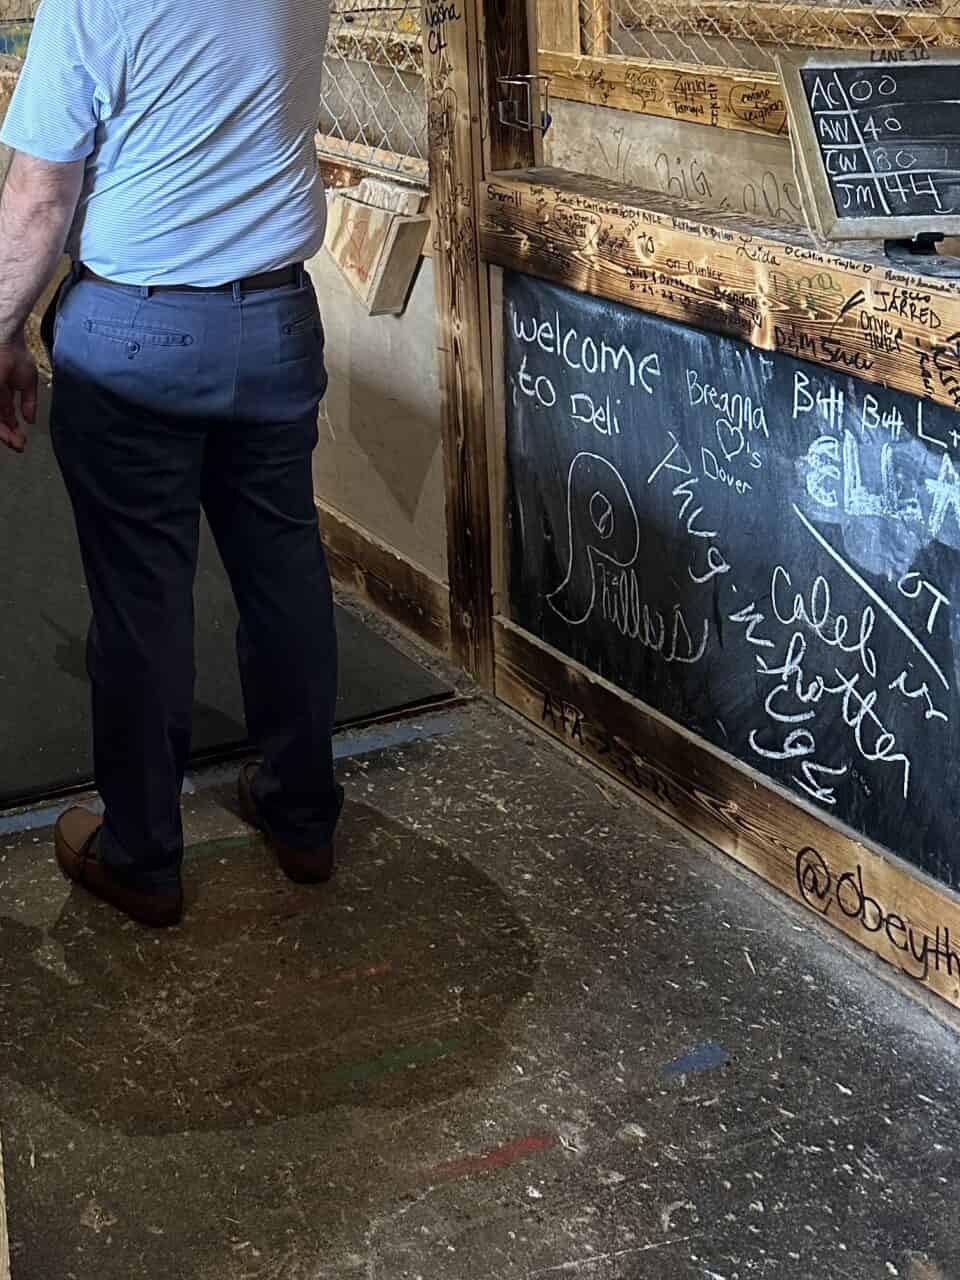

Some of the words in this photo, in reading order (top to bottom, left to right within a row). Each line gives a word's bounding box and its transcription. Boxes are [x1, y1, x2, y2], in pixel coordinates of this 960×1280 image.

[870, 50, 907, 63] LANE
[810, 76, 841, 109] AC
[819, 117, 849, 143] AW
[863, 115, 902, 142] 40
[836, 183, 876, 209] JM
[513, 310, 662, 394] welcome
[517, 354, 556, 407] to
[686, 368, 770, 439] Breanna
[570, 393, 621, 437] Deli
[700, 447, 753, 495] Dover
[771, 565, 878, 678] Caleb
